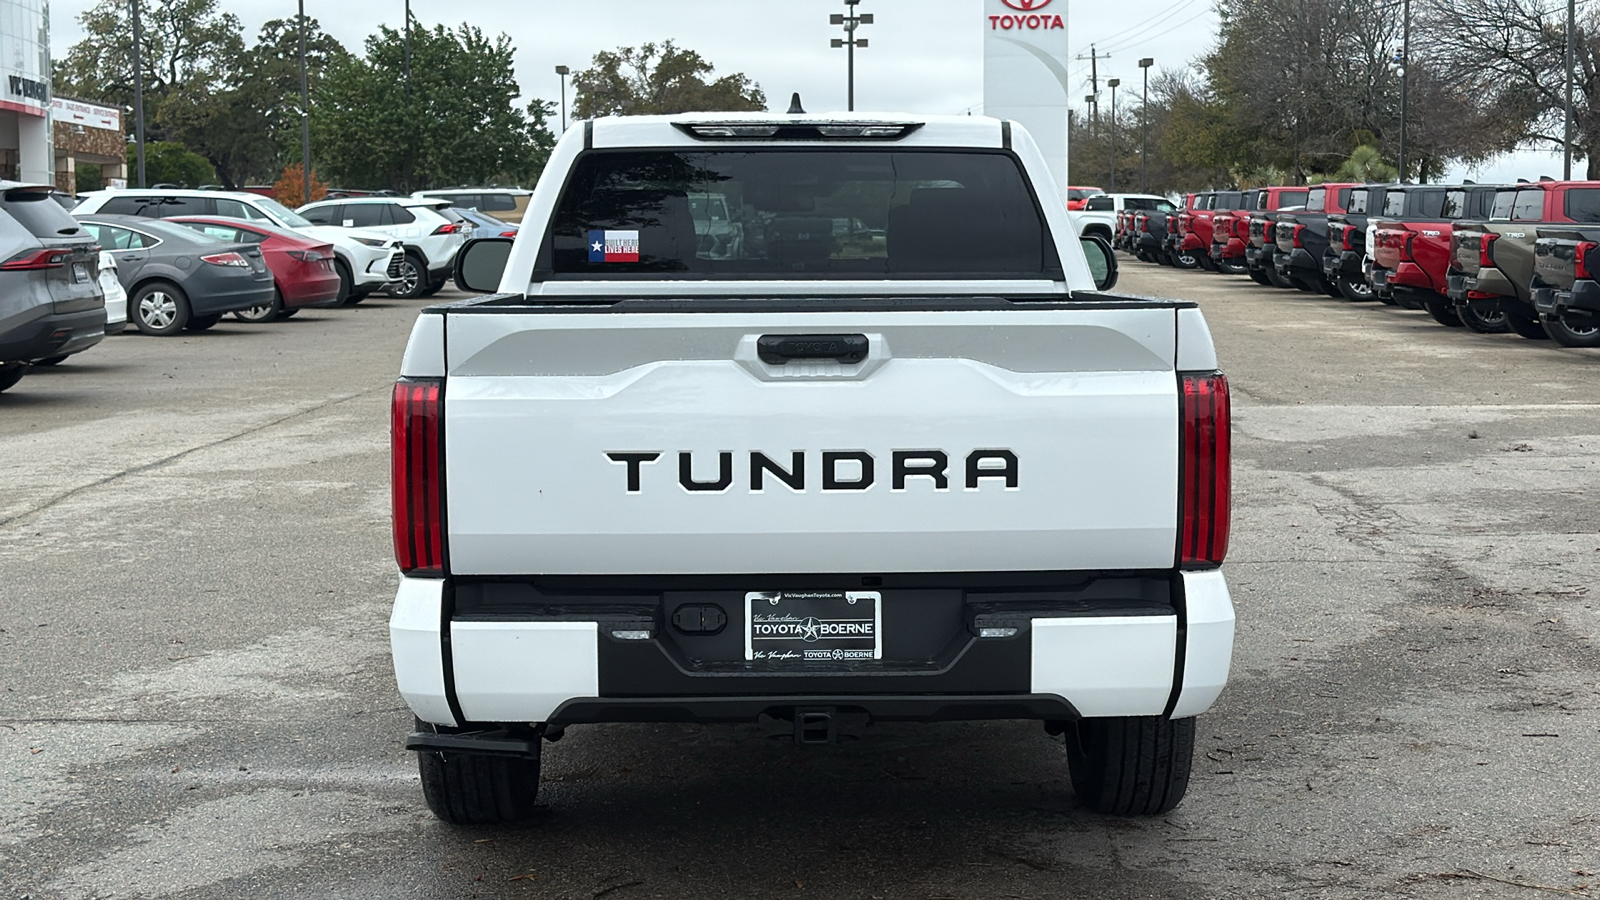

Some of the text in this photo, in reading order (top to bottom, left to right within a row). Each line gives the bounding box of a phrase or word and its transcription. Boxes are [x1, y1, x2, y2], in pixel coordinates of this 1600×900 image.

[988, 14, 1064, 30] TOYOTA
[604, 246, 639, 254] LIVES HERE
[603, 448, 1021, 495] TUNDRA
[754, 623, 873, 634] TOYOTA BOERNE
